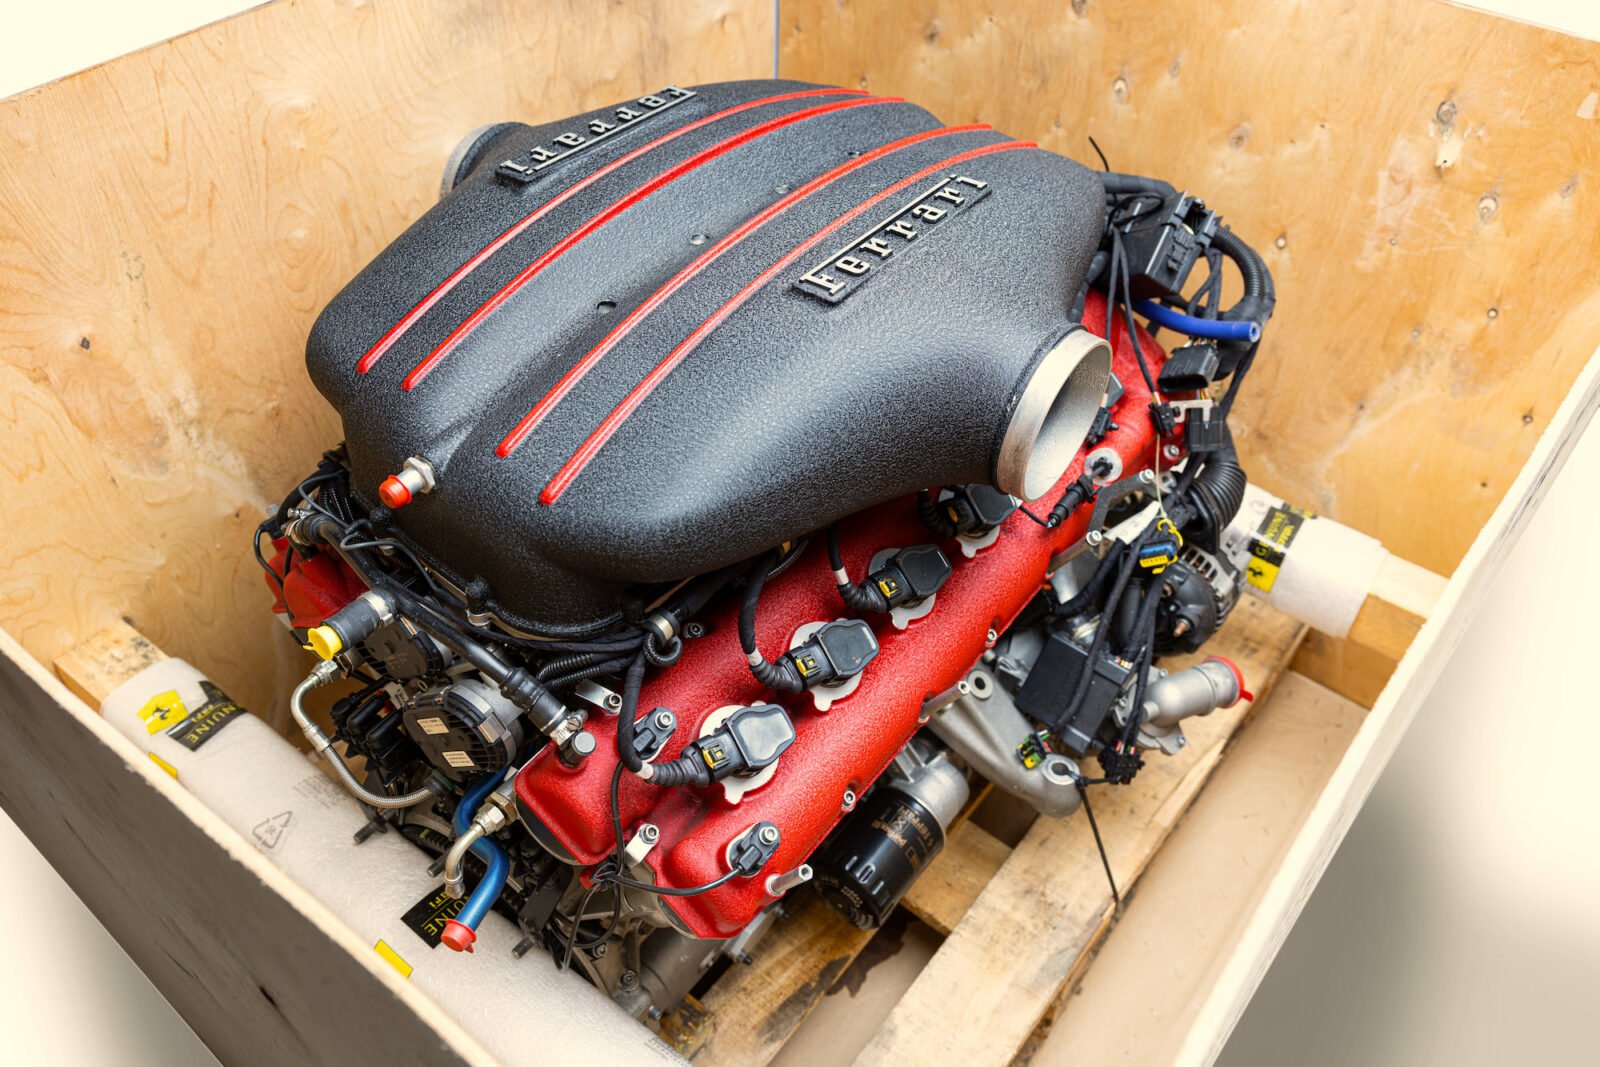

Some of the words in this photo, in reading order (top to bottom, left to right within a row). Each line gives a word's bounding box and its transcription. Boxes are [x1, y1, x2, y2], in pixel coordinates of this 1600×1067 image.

[500, 85, 697, 176] Ferrari
[799, 174, 988, 295] Ferrari
[187, 703, 238, 743] NUINE
